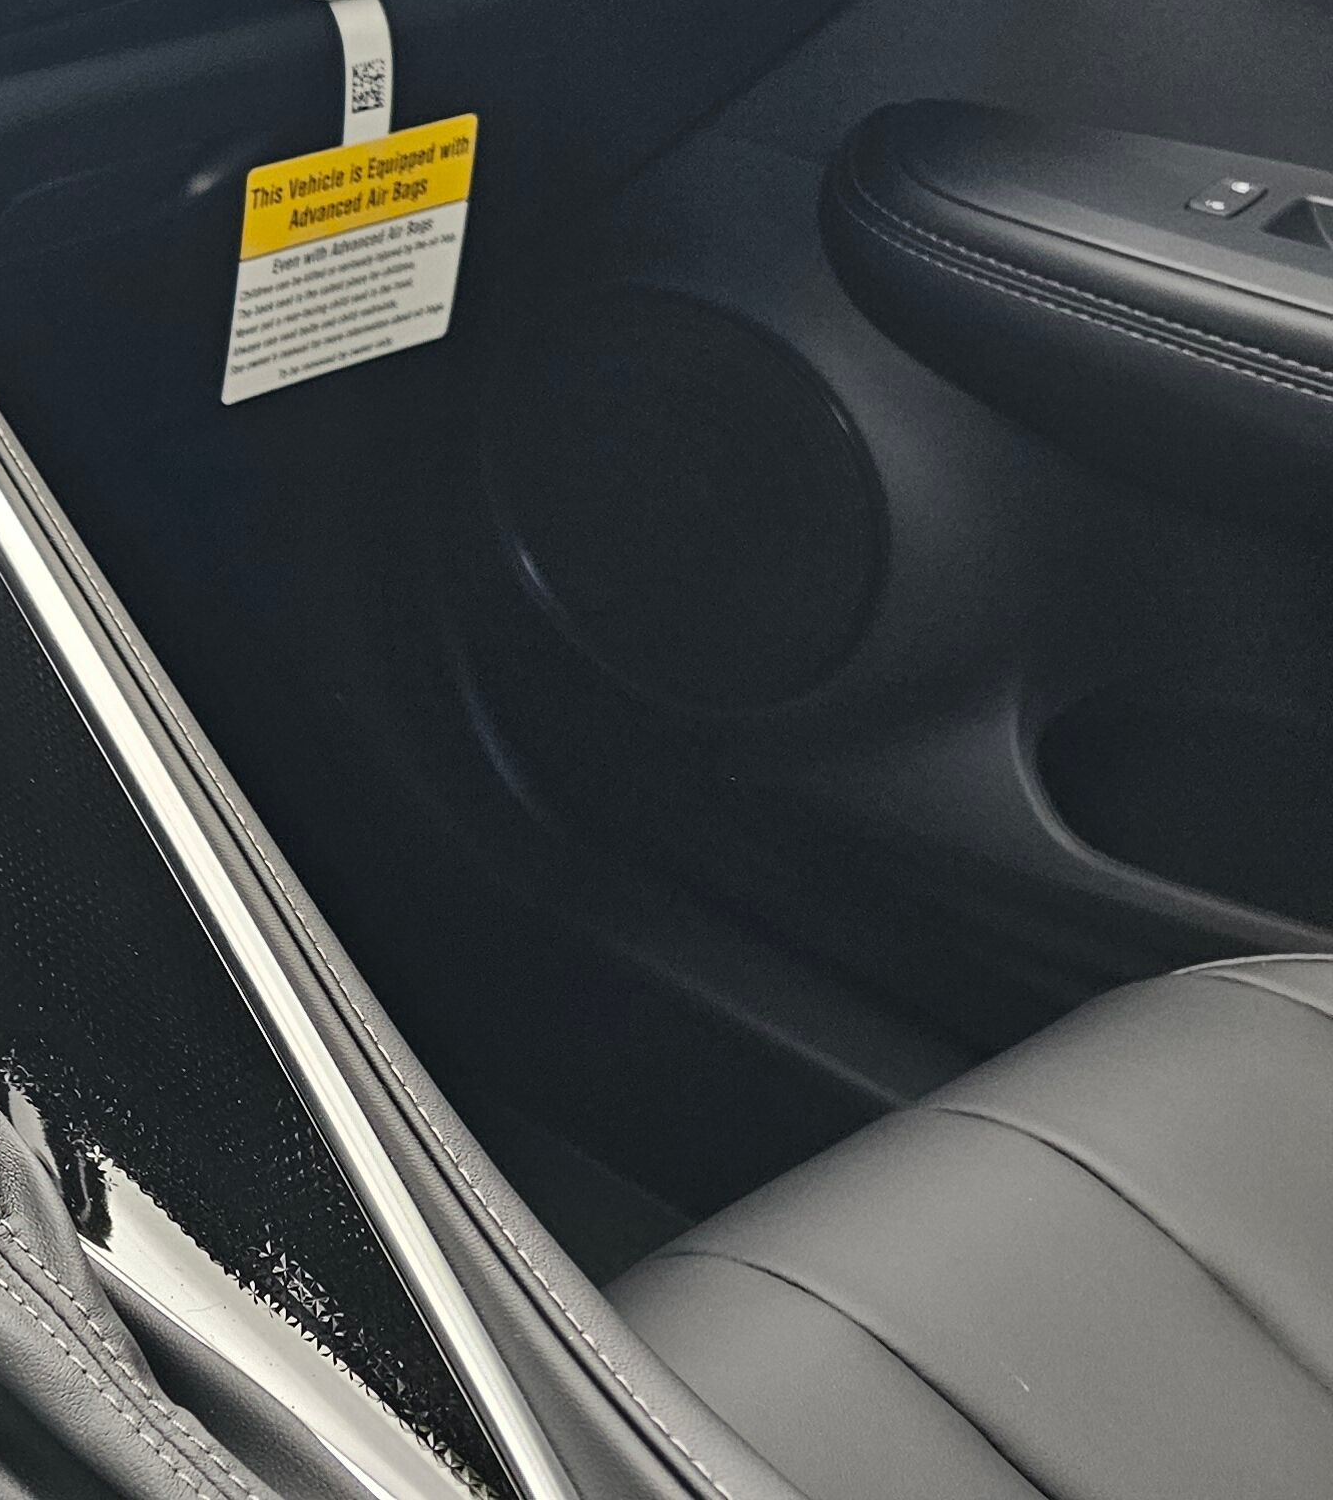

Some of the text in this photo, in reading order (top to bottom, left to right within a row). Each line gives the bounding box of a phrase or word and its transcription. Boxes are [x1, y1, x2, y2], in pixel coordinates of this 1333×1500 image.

[251, 135, 470, 210] This Vehicle is Equipped with
[289, 178, 428, 229] Advanced Air Bags
